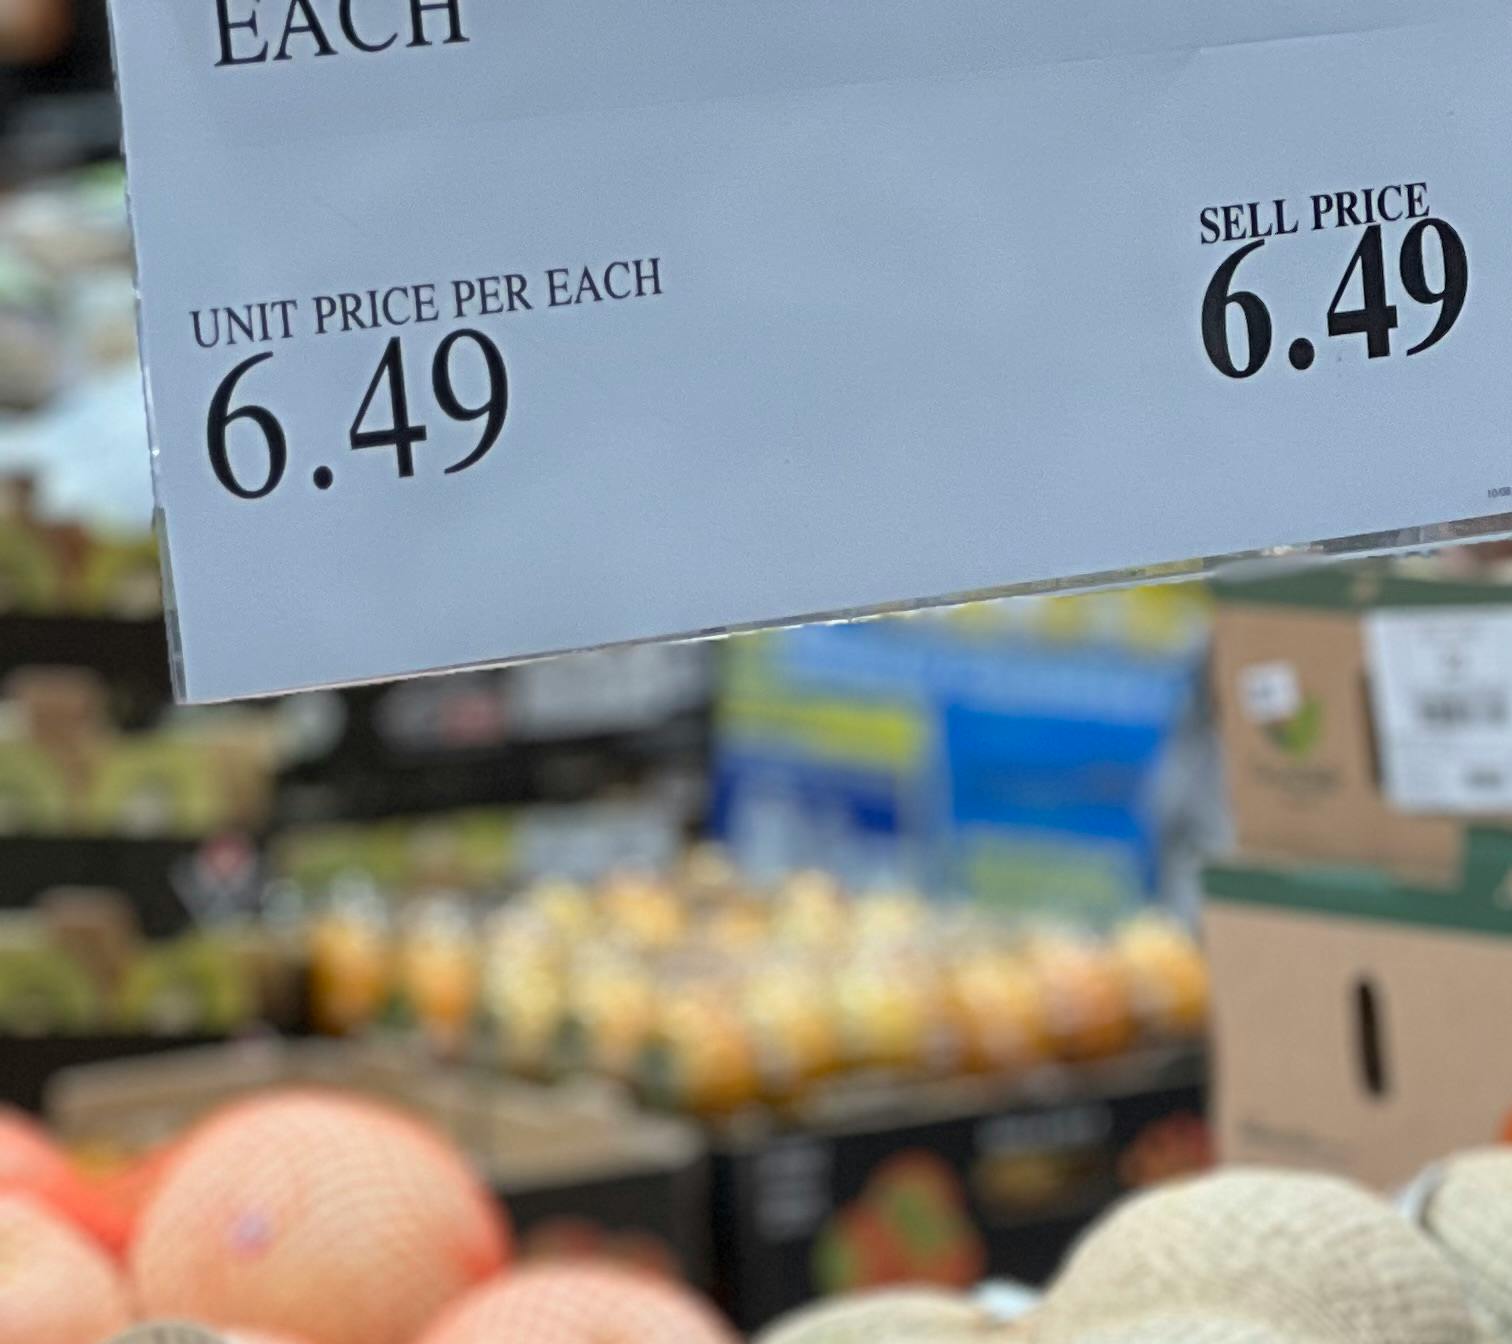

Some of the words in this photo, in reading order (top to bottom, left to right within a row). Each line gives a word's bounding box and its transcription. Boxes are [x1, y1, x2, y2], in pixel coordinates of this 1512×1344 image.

[214, 0, 470, 66] EACH
[1200, 199, 1299, 245] SELL
[1310, 182, 1431, 231] PRICE
[190, 300, 297, 348] UNIT
[313, 283, 439, 335] PRICE
[452, 273, 534, 319] PER
[544, 257, 665, 308] EACH
[1201, 217, 1469, 379] 6.49
[206, 328, 509, 500] 6.49
